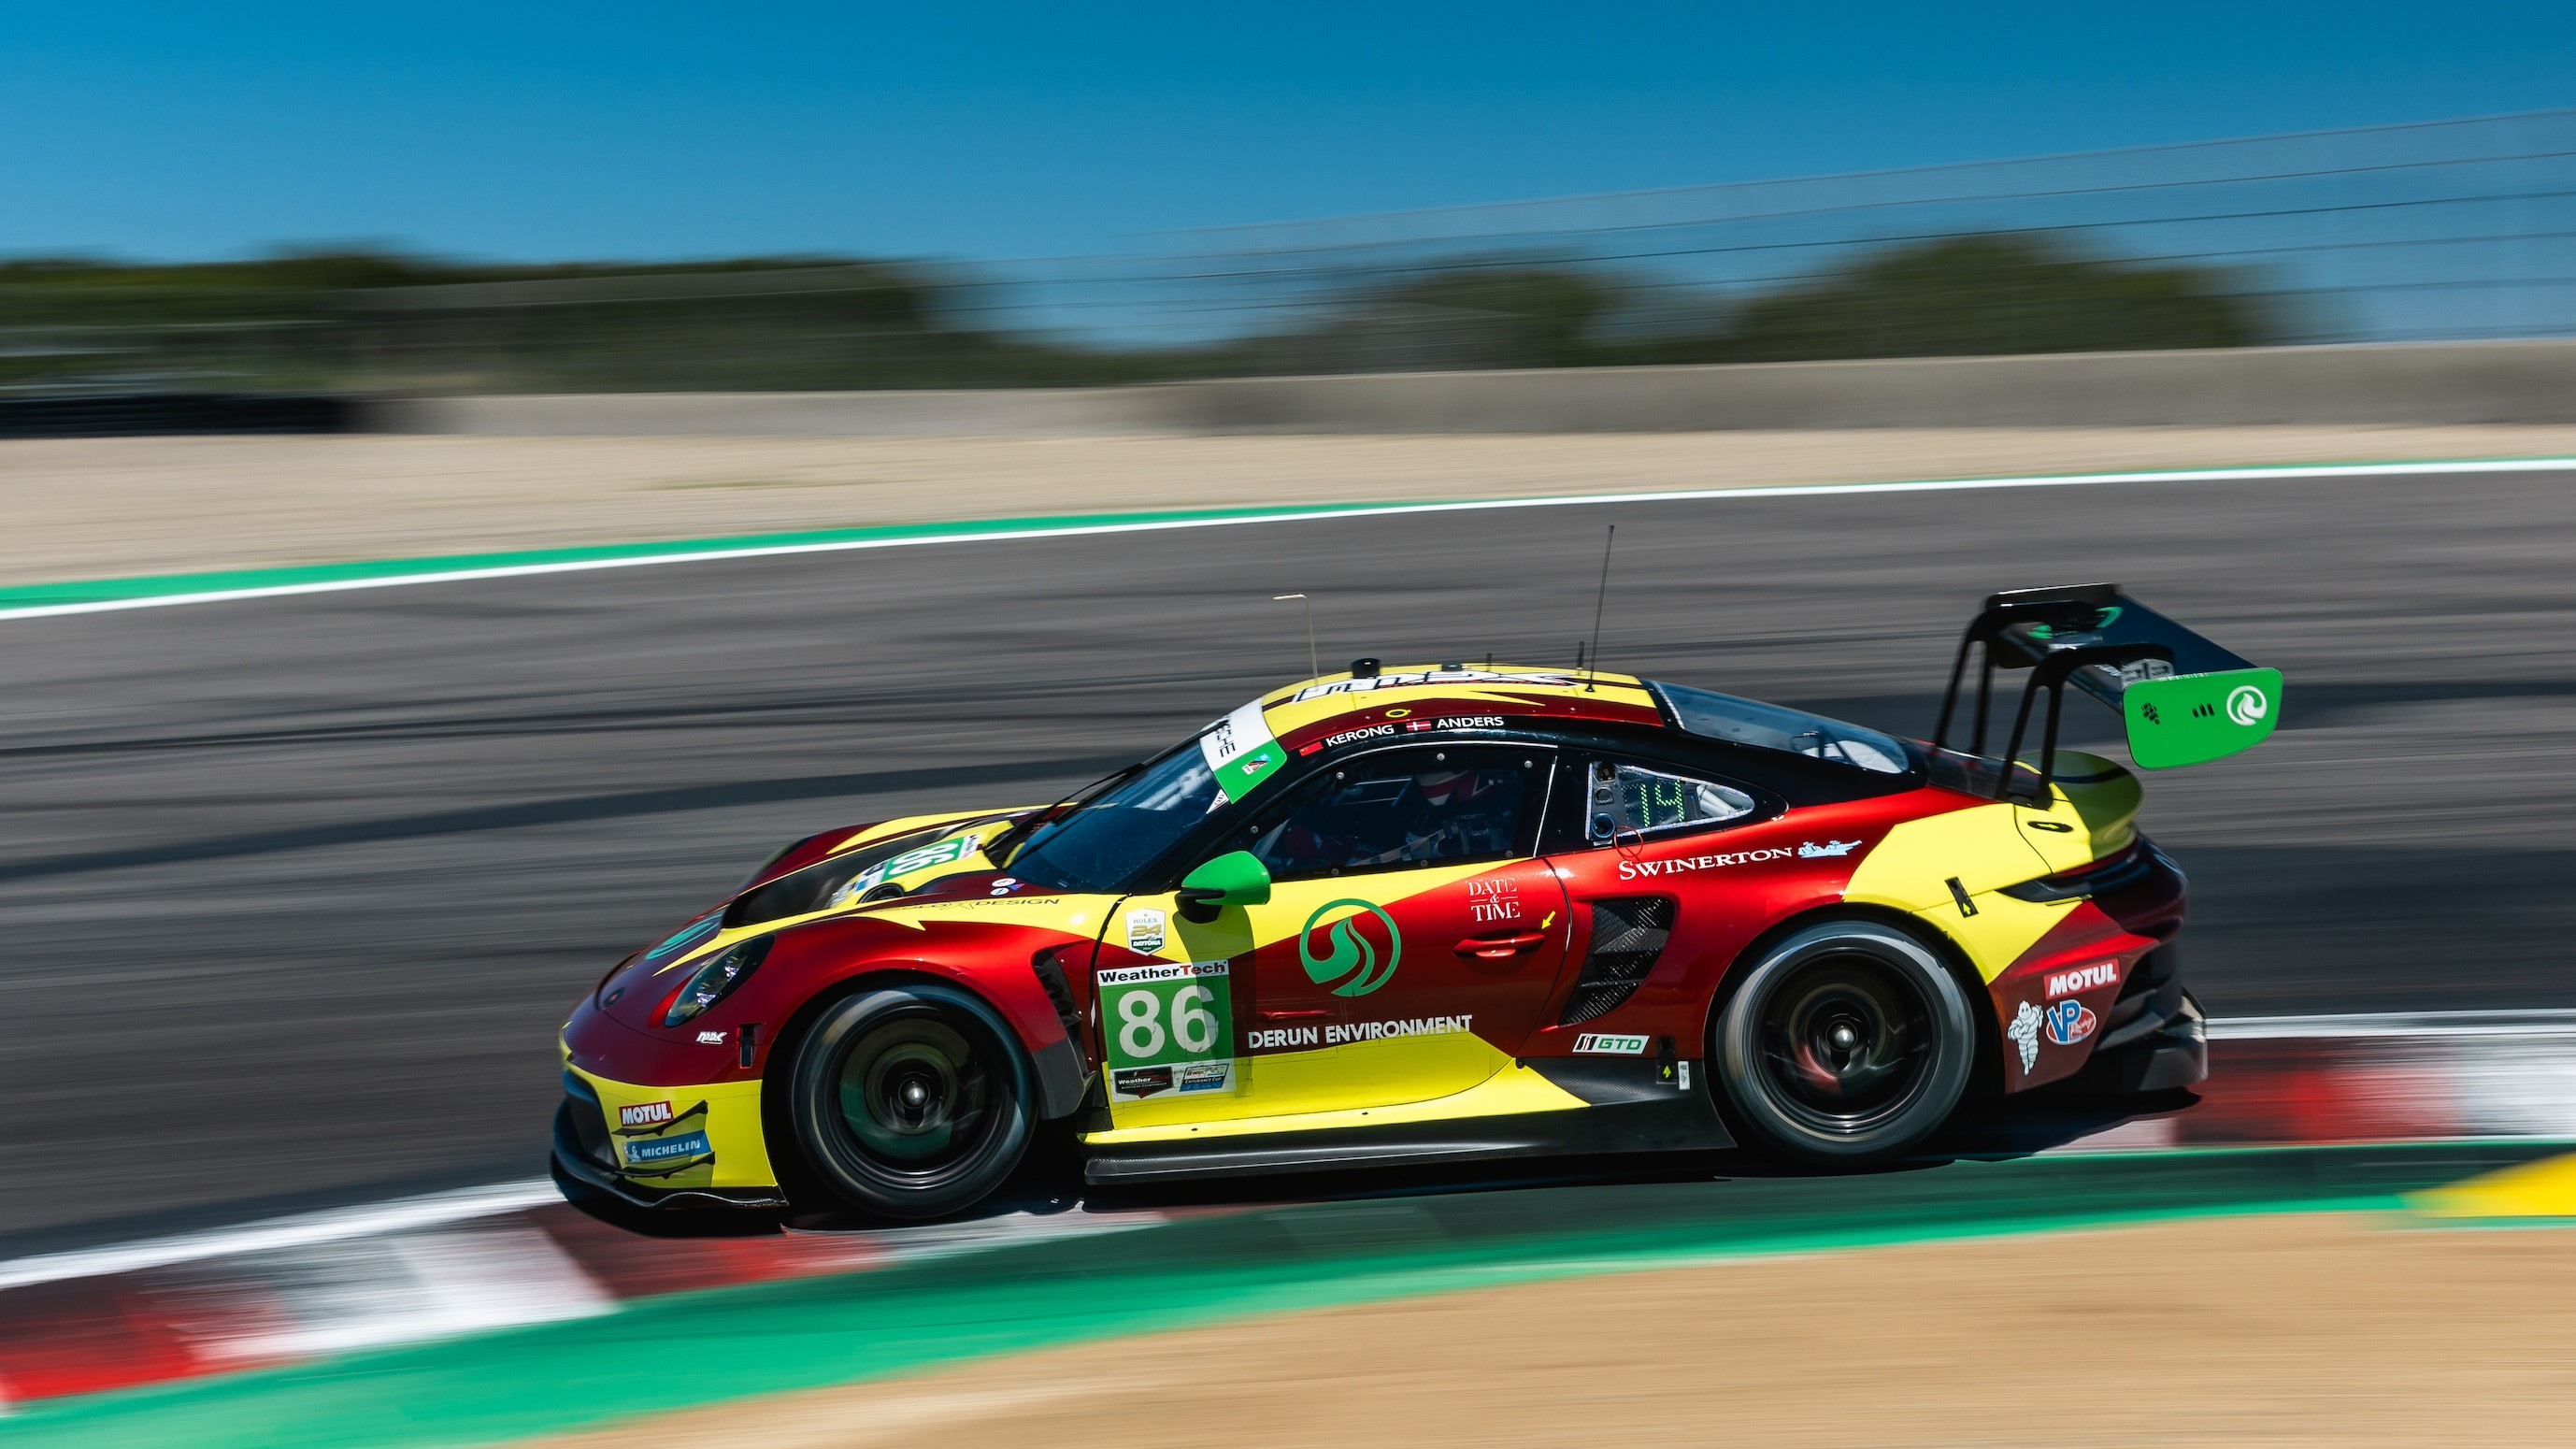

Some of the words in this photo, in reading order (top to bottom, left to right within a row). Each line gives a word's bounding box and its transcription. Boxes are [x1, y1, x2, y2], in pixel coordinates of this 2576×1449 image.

[1324, 723, 1395, 749] KERONG
[1436, 715, 1505, 729] ANDERS
[1639, 778, 1685, 828] 14
[889, 842, 959, 876] 86
[1619, 847, 1793, 881] SWINERTON
[1465, 878, 1518, 897] DATE
[1489, 893, 1500, 904] &
[1470, 901, 1521, 922] TIME
[1130, 924, 1163, 937] 24
[1099, 961, 1227, 983] WeatherTech
[2049, 963, 2117, 997] MOTUL
[1118, 984, 1219, 1058] 86
[1249, 1027, 1318, 1049] DERUN
[1325, 1014, 1473, 1042] ENVIRONMENT
[2046, 999, 2082, 1044] VP
[1597, 1038, 1642, 1051] GTD
[622, 1103, 672, 1125] MOTUL
[641, 1139, 701, 1157] MICHELIN
